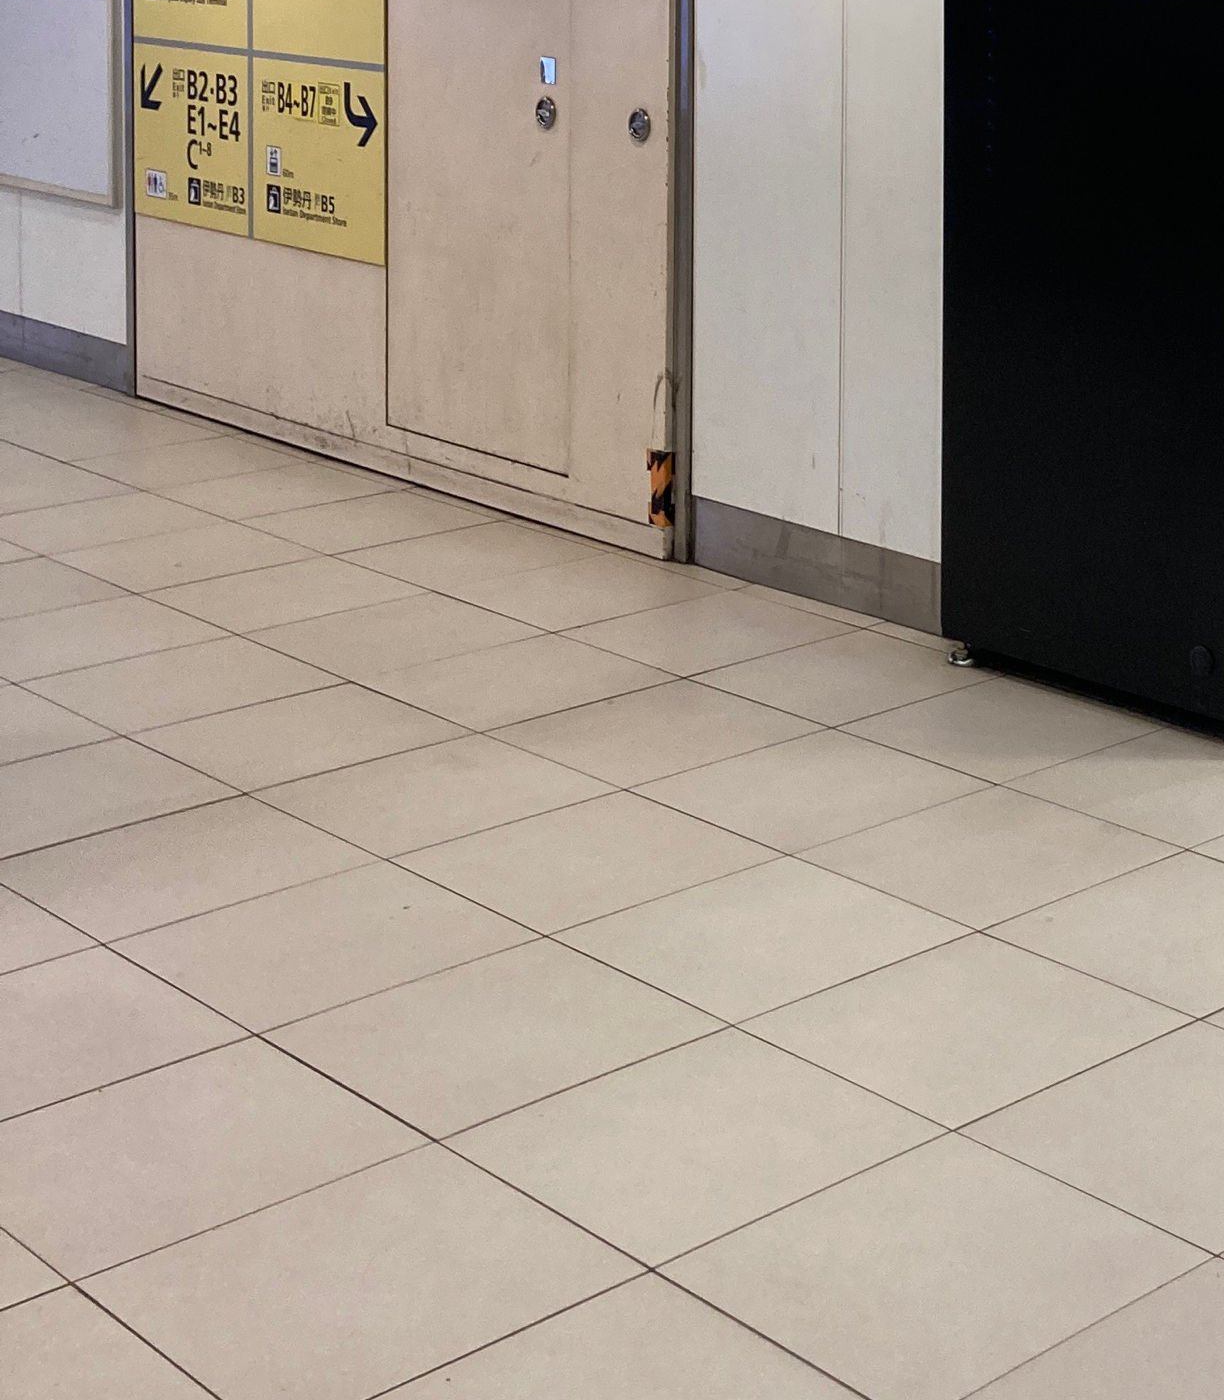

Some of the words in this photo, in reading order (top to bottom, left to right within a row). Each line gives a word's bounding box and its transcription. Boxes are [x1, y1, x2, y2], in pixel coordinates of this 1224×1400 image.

[203, 180, 224, 201] 伊勢丹
[232, 186, 245, 204] B3
[283, 187, 312, 210] 伊勢丹
[321, 195, 335, 214] B5
